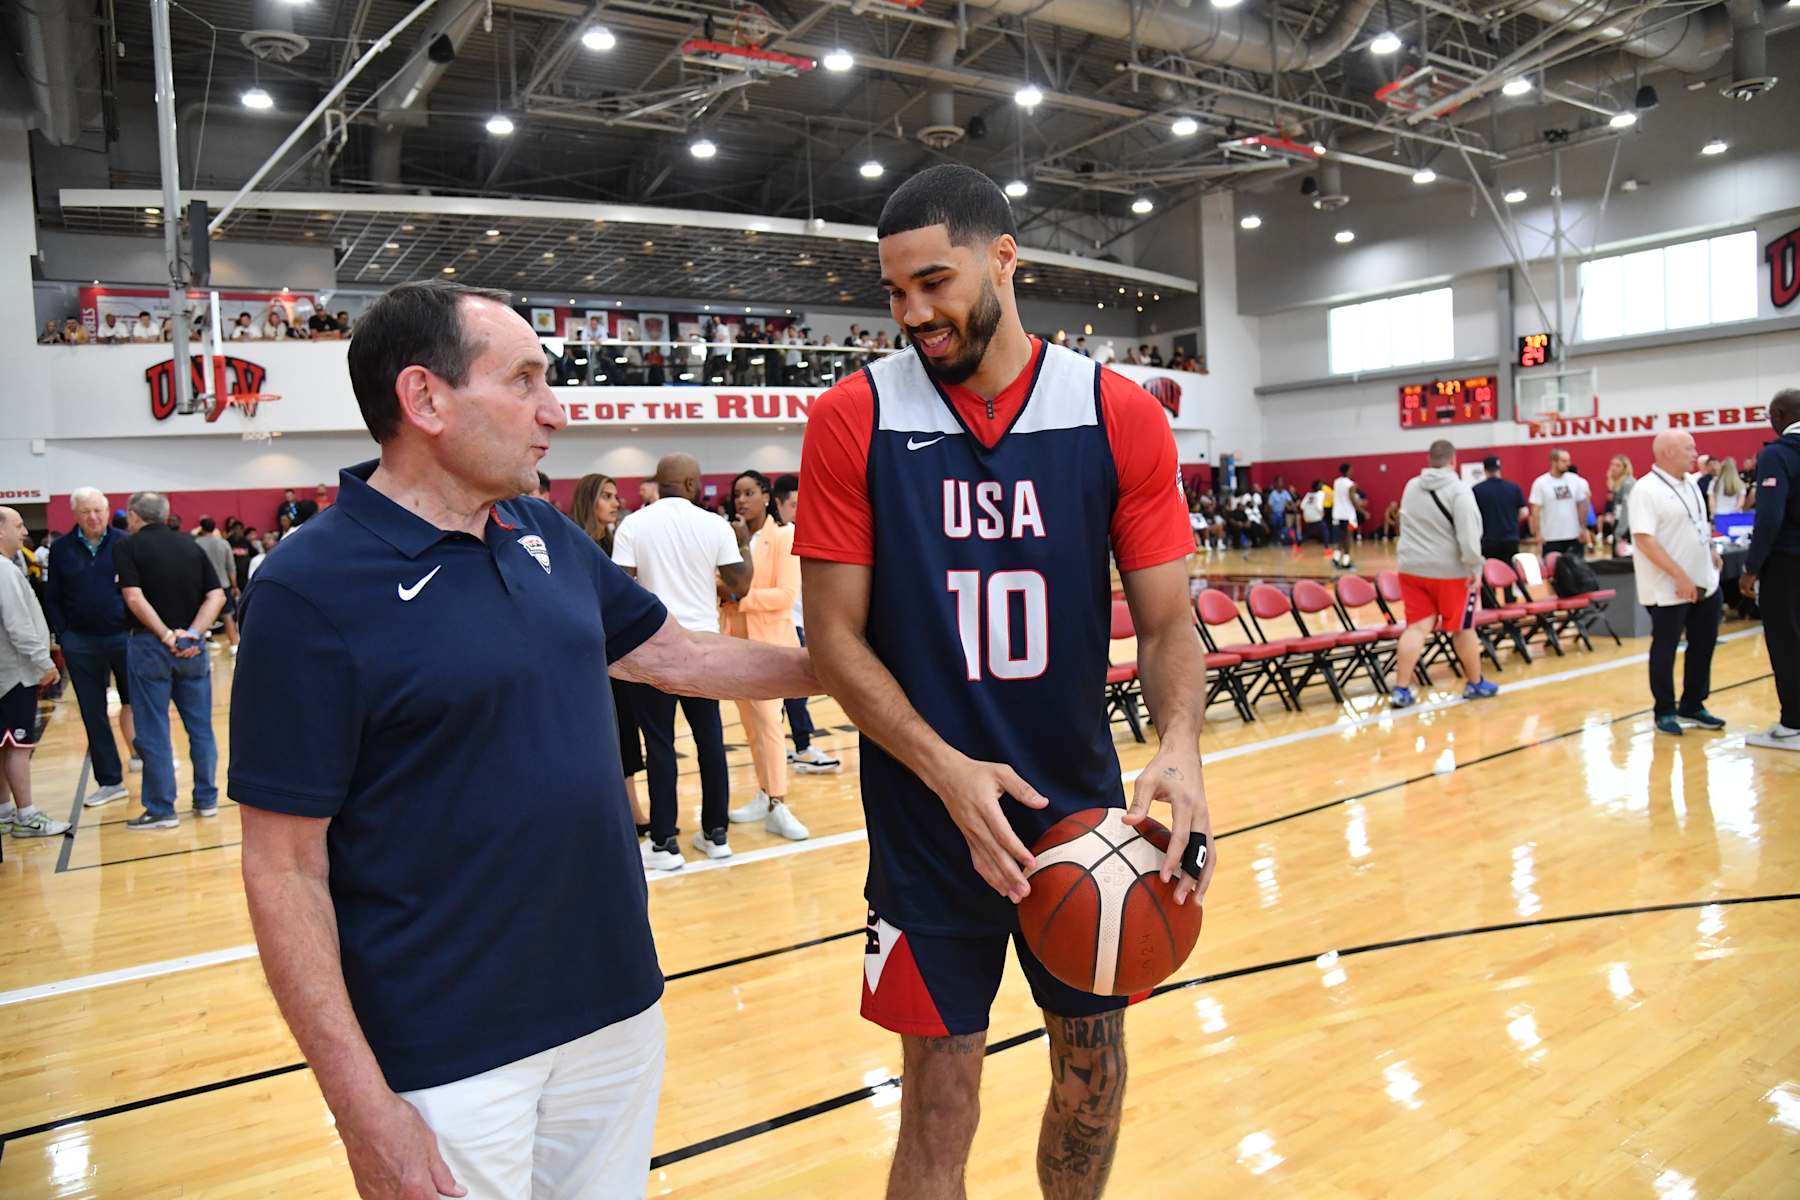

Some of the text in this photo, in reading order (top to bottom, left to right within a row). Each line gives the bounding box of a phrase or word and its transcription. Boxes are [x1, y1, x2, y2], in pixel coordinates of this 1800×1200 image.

[1521, 346, 1545, 367] 24
[145, 354, 266, 421] UV
[560, 403, 589, 420] E
[594, 403, 635, 419] OF
[642, 402, 704, 419] THE
[942, 479, 1046, 539] USA
[946, 569, 1049, 682] 10
